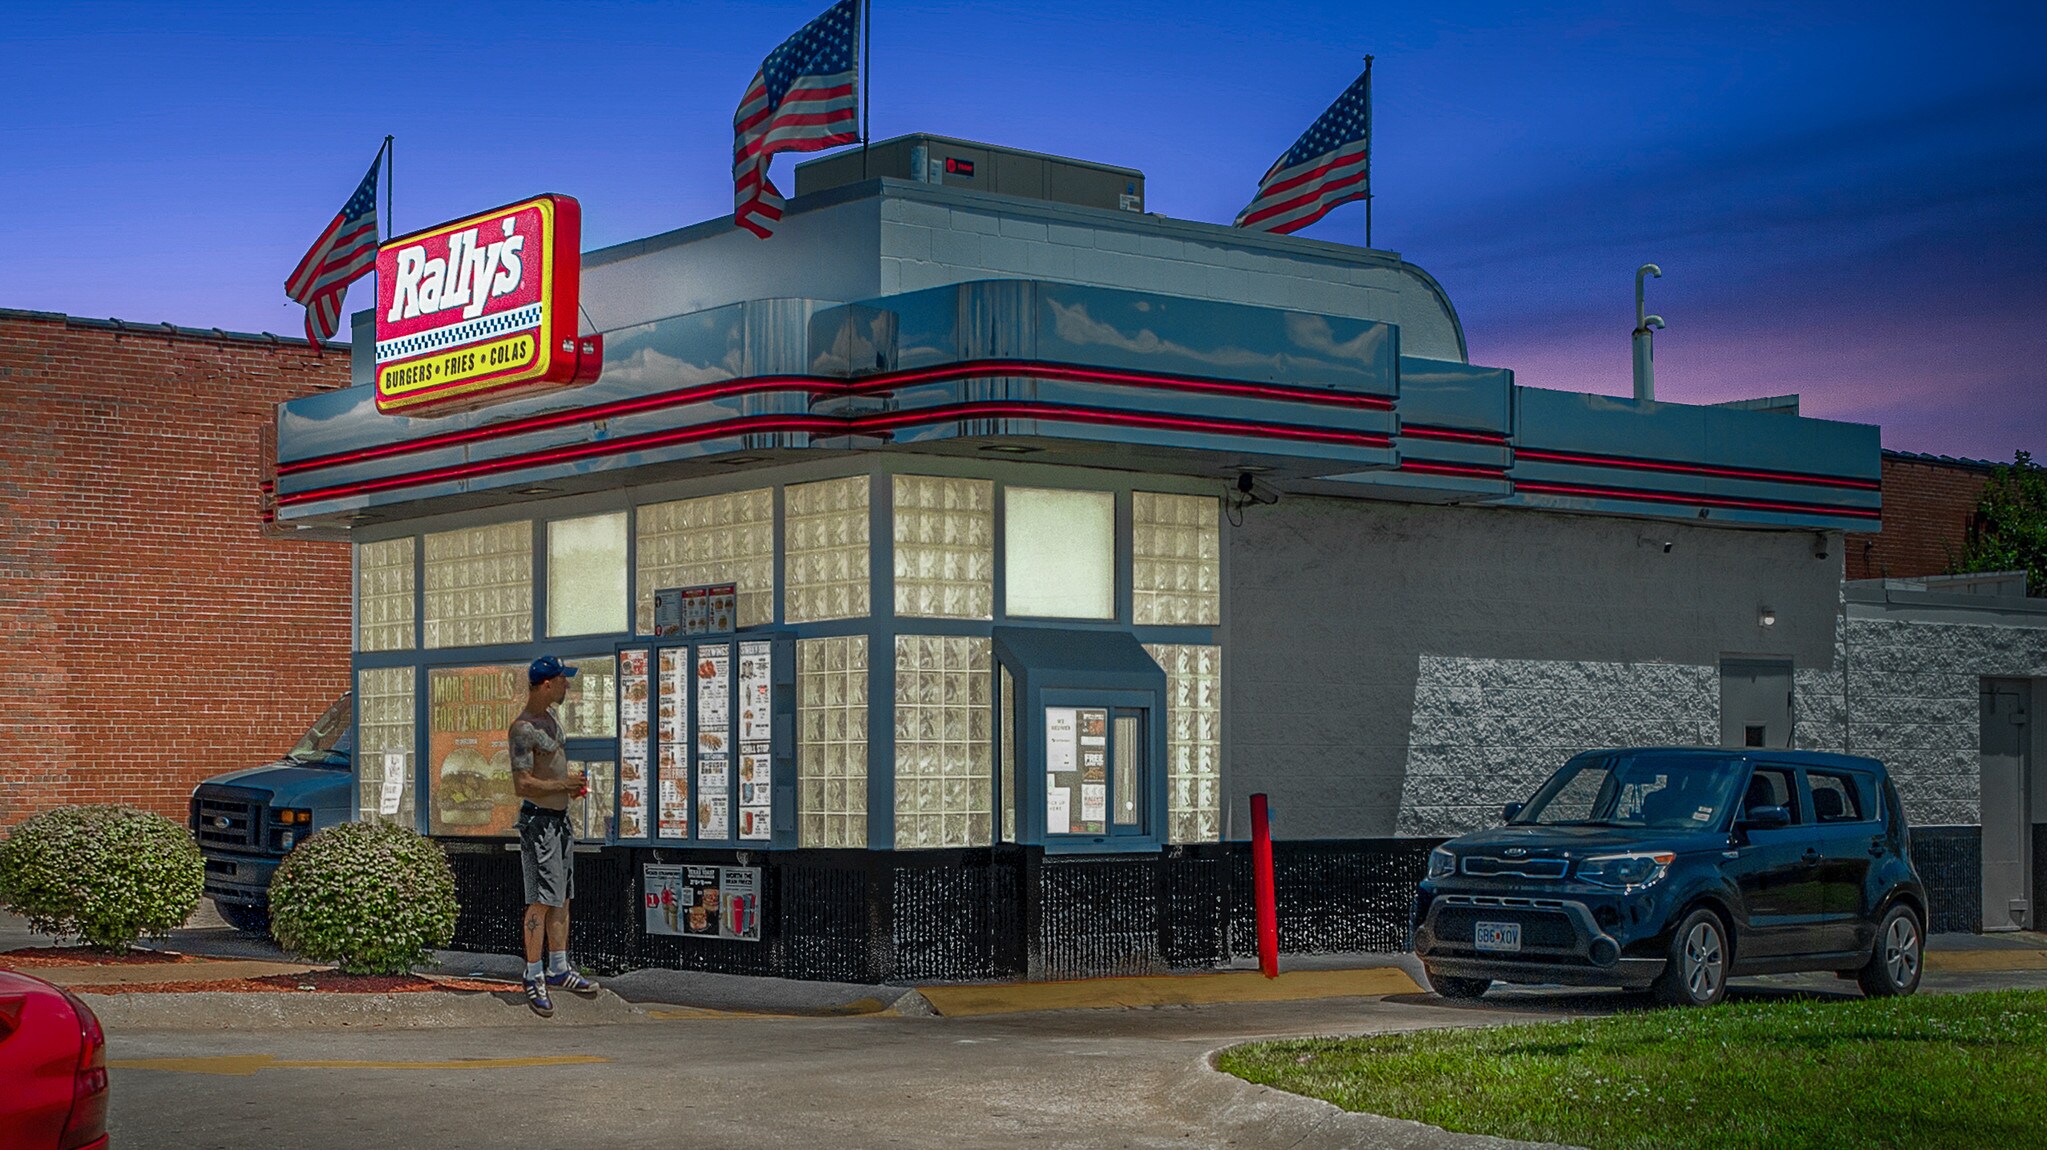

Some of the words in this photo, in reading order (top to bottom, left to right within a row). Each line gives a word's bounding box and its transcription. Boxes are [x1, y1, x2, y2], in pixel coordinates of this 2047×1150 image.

[388, 217, 524, 322] Rally's
[386, 363, 432, 389] BURGERS
[444, 353, 475, 376] FRIES
[490, 341, 527, 367] COLAS
[434, 676, 465, 703] MORE
[468, 671, 513, 701] THRILLS
[434, 706, 454, 732] FOR
[457, 704, 492, 732] FEWER
